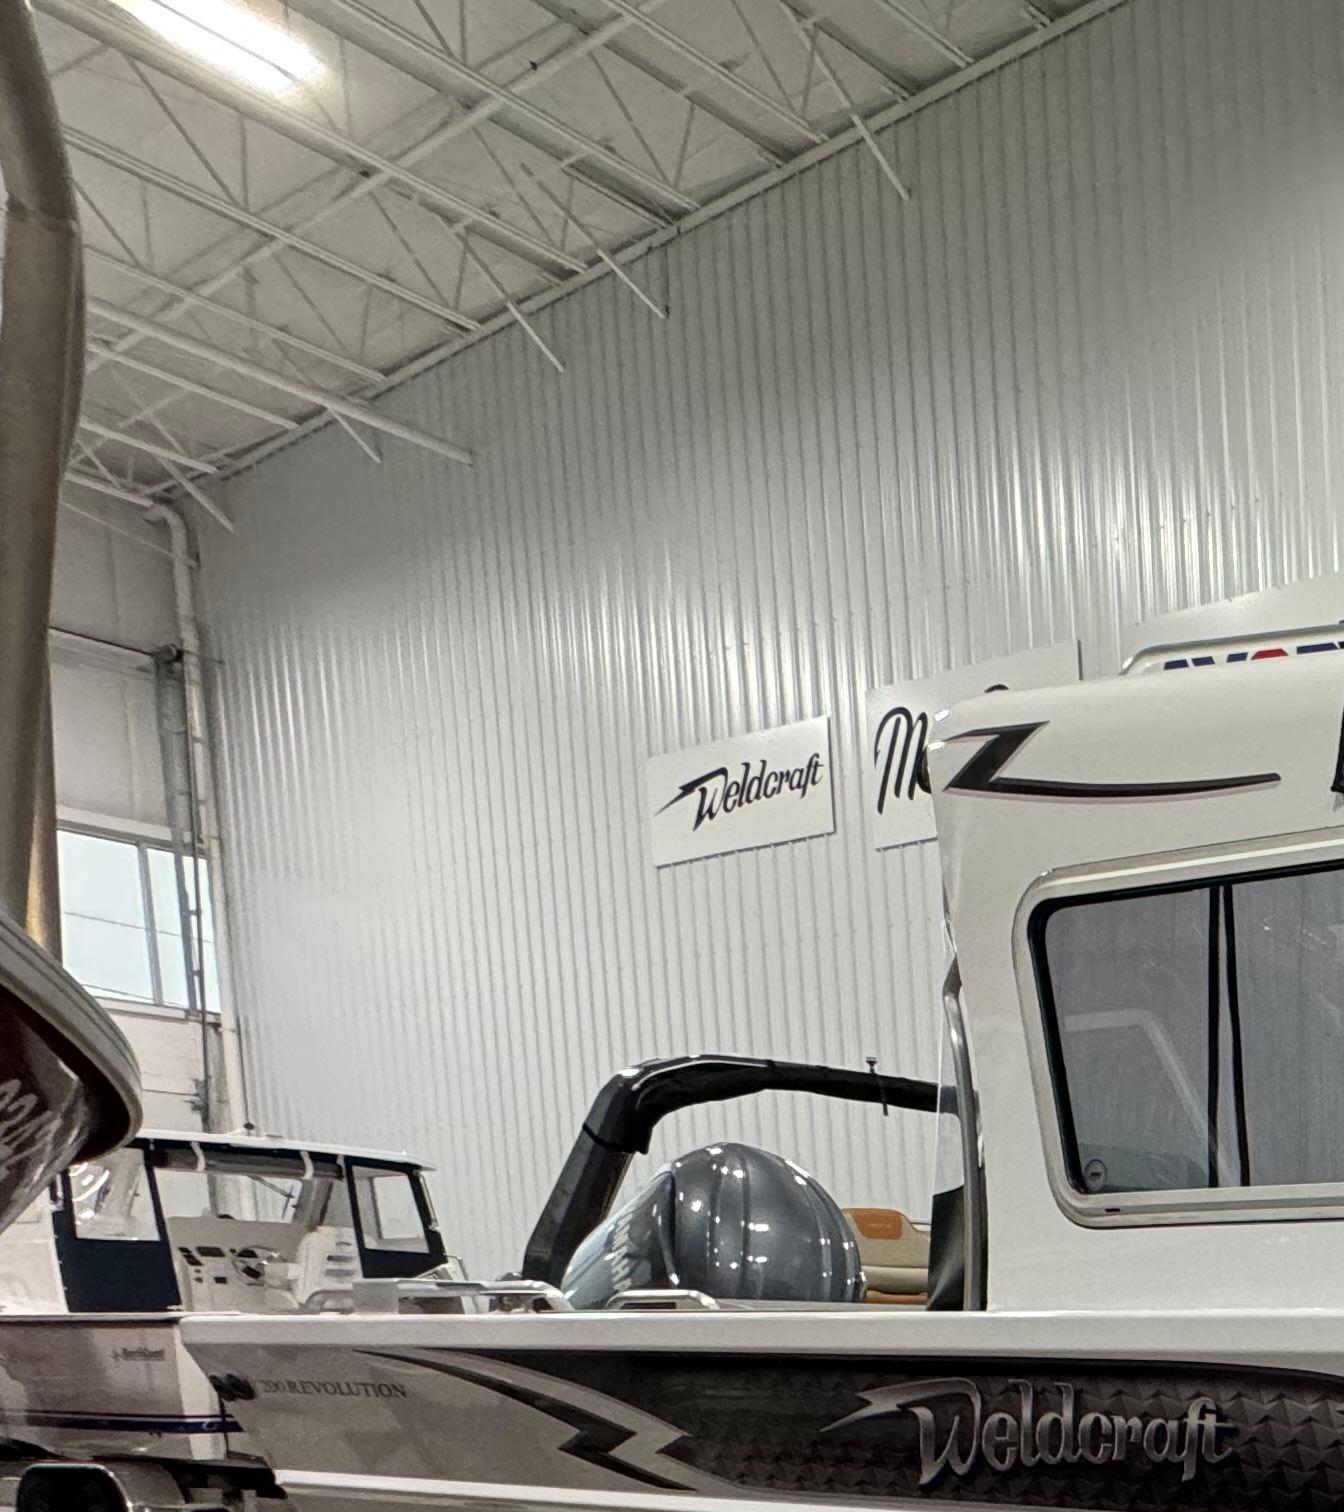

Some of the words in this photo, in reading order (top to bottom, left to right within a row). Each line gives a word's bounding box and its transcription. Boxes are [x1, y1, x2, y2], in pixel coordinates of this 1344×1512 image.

[654, 752, 825, 832] Weldcraft
[286, 1380, 408, 1398] REVOLUTION
[819, 1376, 1236, 1486] Weldcraft
